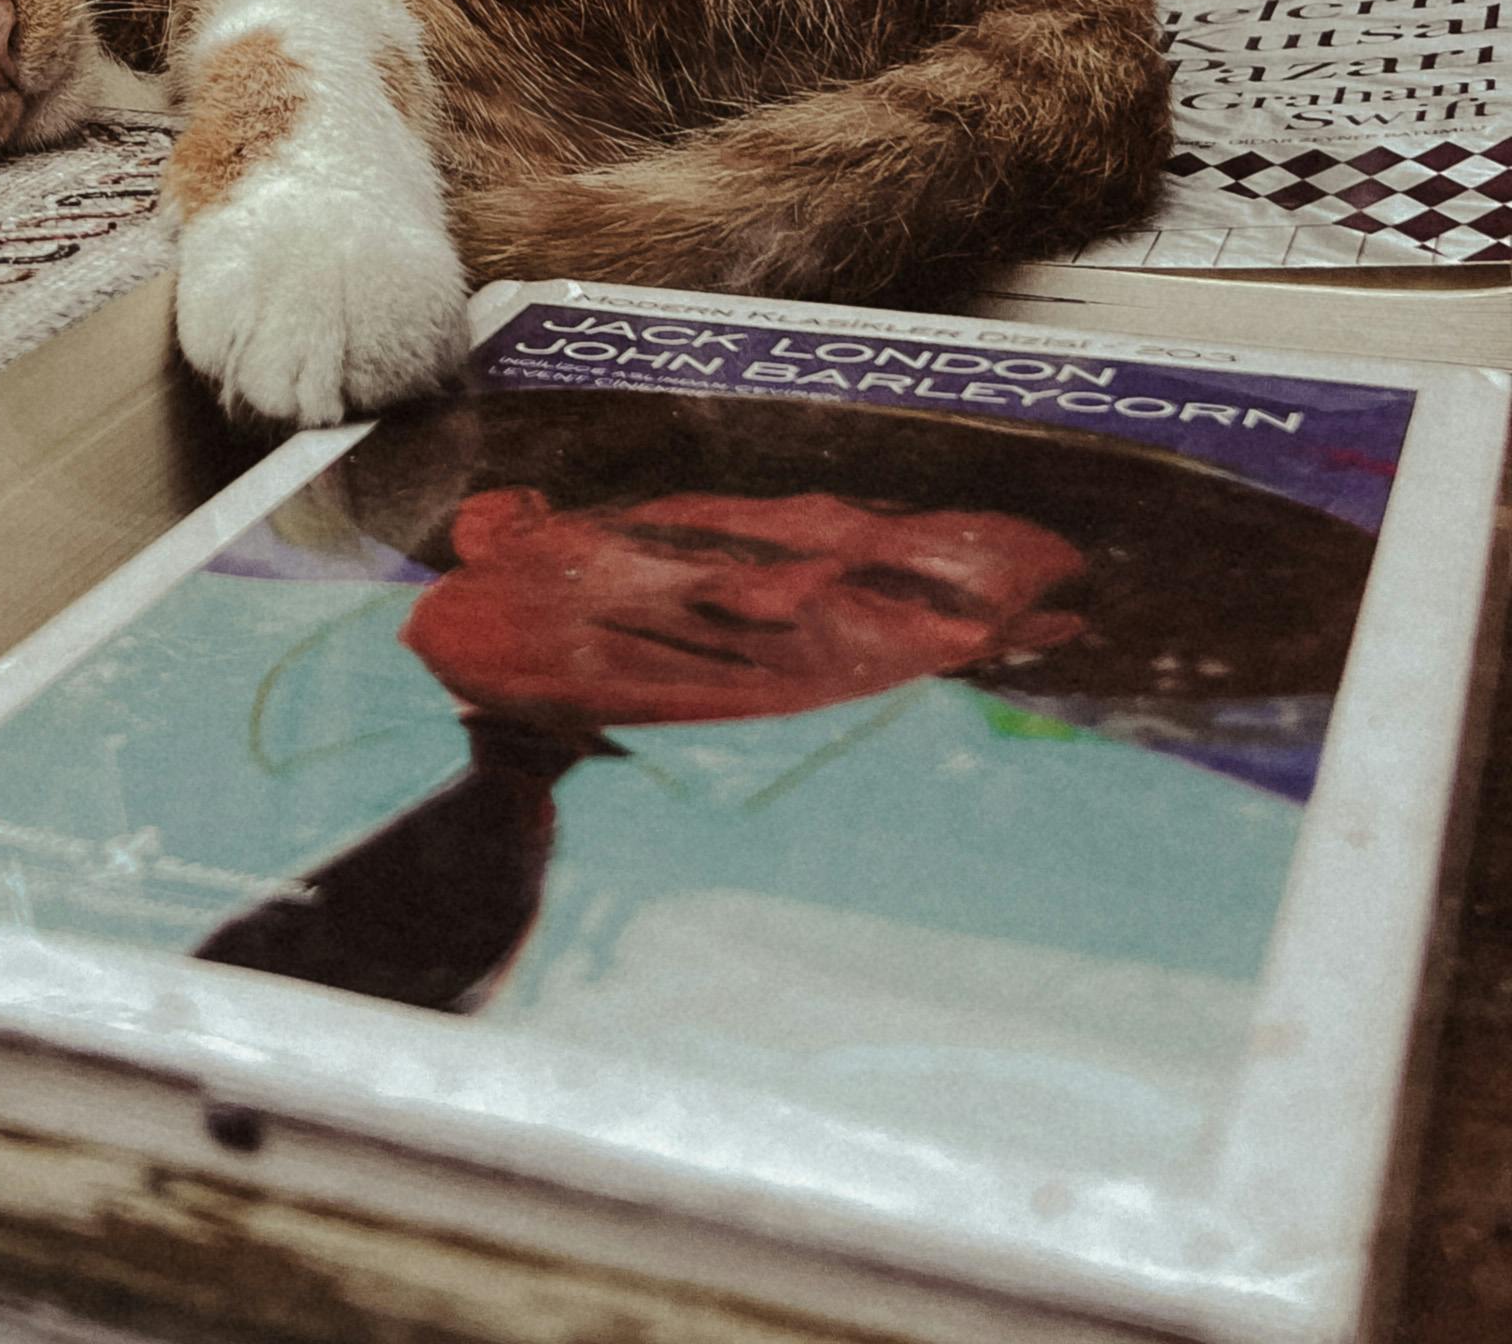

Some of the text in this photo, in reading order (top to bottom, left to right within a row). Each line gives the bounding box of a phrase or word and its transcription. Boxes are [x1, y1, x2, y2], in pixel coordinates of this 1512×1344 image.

[1157, 2, 1502, 55] Kutsal
[1168, 44, 1497, 86] Pazarı
[1180, 77, 1498, 111] Graham
[1284, 96, 1492, 132] Swift
[574, 292, 735, 318] MODERN
[541, 316, 1118, 389] JACK LONDON
[514, 337, 1309, 436] JOHN BARLEYCORN
